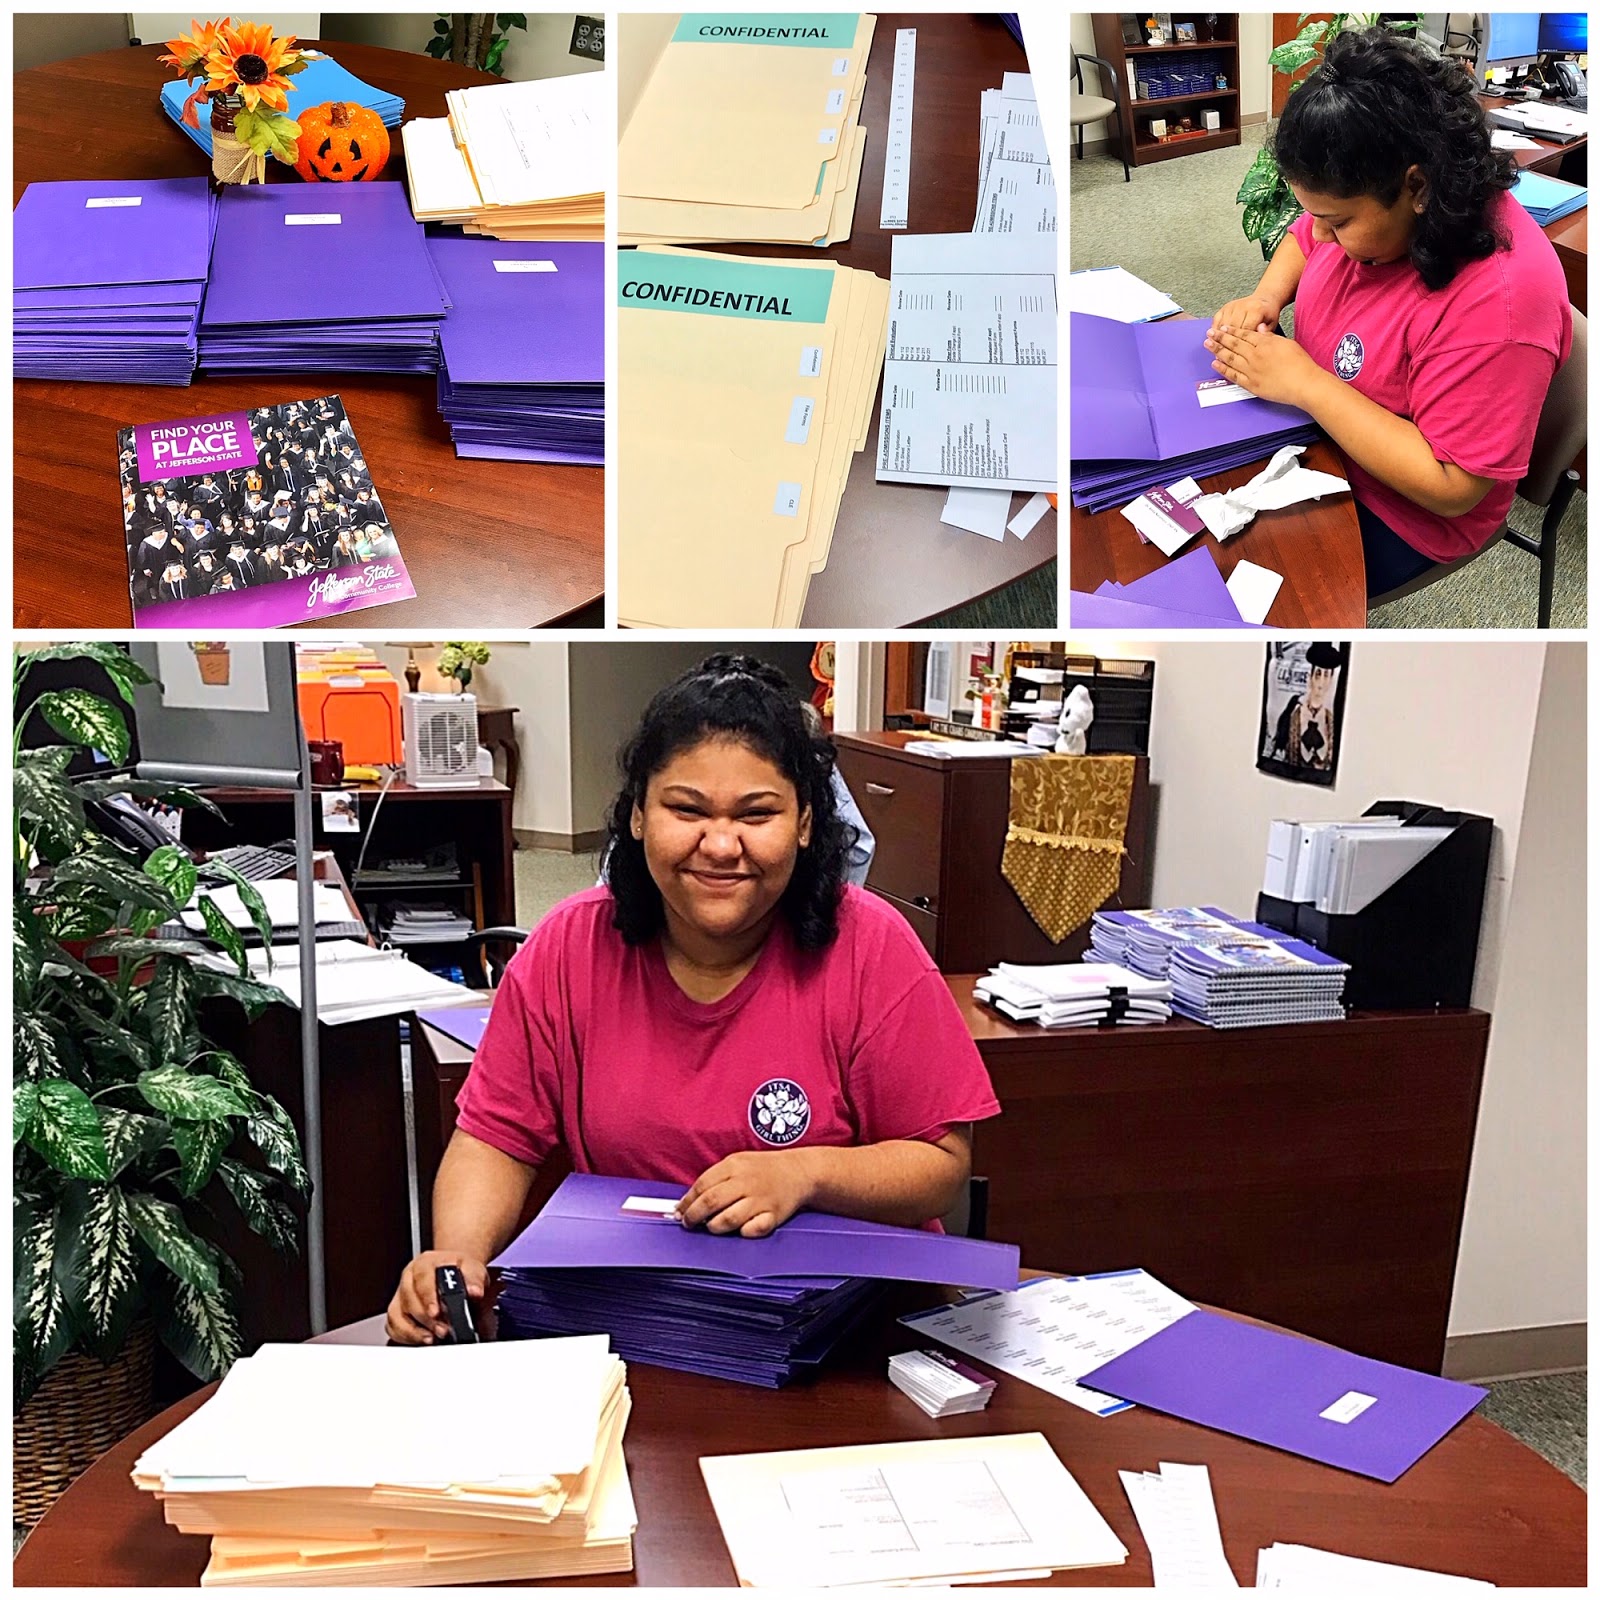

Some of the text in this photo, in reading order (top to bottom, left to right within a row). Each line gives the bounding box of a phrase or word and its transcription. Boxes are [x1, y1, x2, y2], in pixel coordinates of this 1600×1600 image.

[699, 25, 829, 38] CONFIDENTIAL
[622, 281, 792, 315] CONFIDENTIAL
[811, 349, 819, 372] Confidential
[150, 420, 235, 440] FIND YOUR
[801, 413, 809, 427] Forms
[152, 431, 240, 460] PLACE
[882, 425, 890, 469] PRE-ADMISSIONS
[155, 451, 242, 470] AT JEFFERSON STATE
[306, 564, 401, 608] Jefferson State
[378, 581, 402, 593] College
[756, 1124, 804, 1142] GIRL THING
